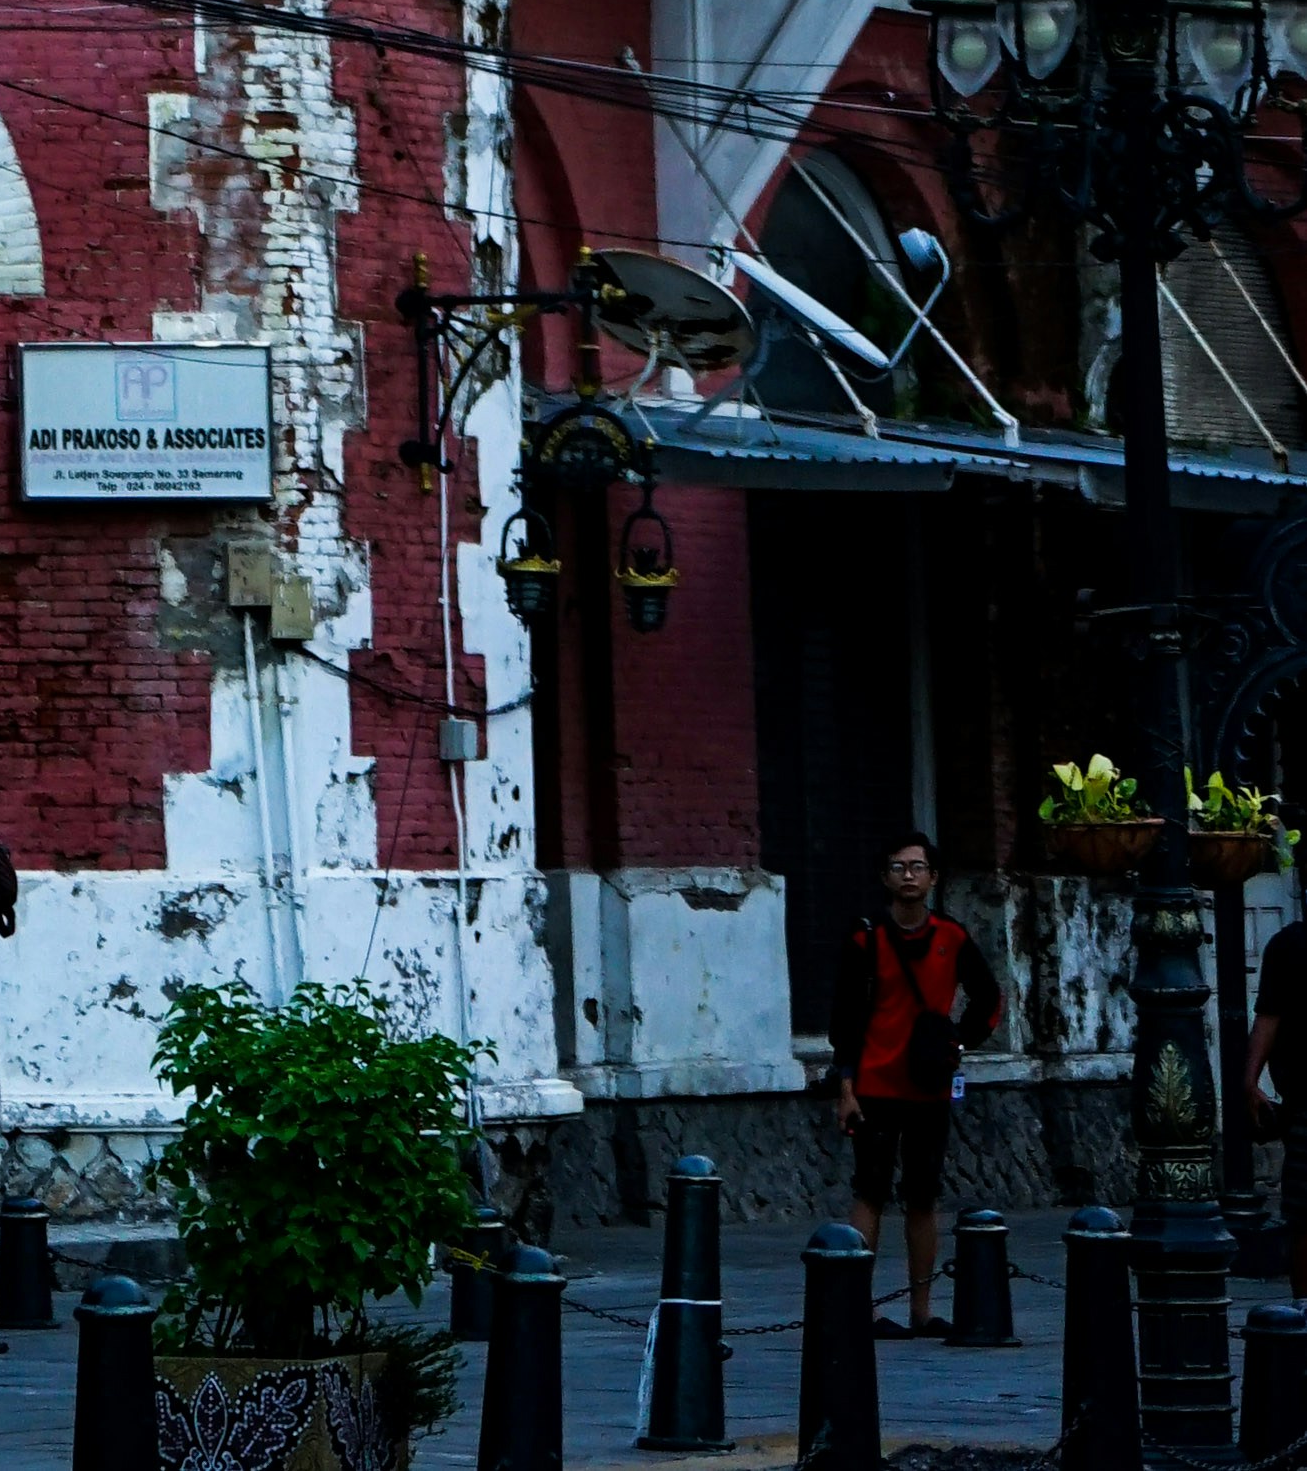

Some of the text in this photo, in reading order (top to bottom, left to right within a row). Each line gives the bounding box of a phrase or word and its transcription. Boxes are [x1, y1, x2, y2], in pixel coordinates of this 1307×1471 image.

[30, 428, 266, 450] ADI PRAKOSO & ASSOCIATES
[157, 469, 174, 479] No.
[177, 469, 189, 479] 33
[192, 469, 243, 480] Semarang
